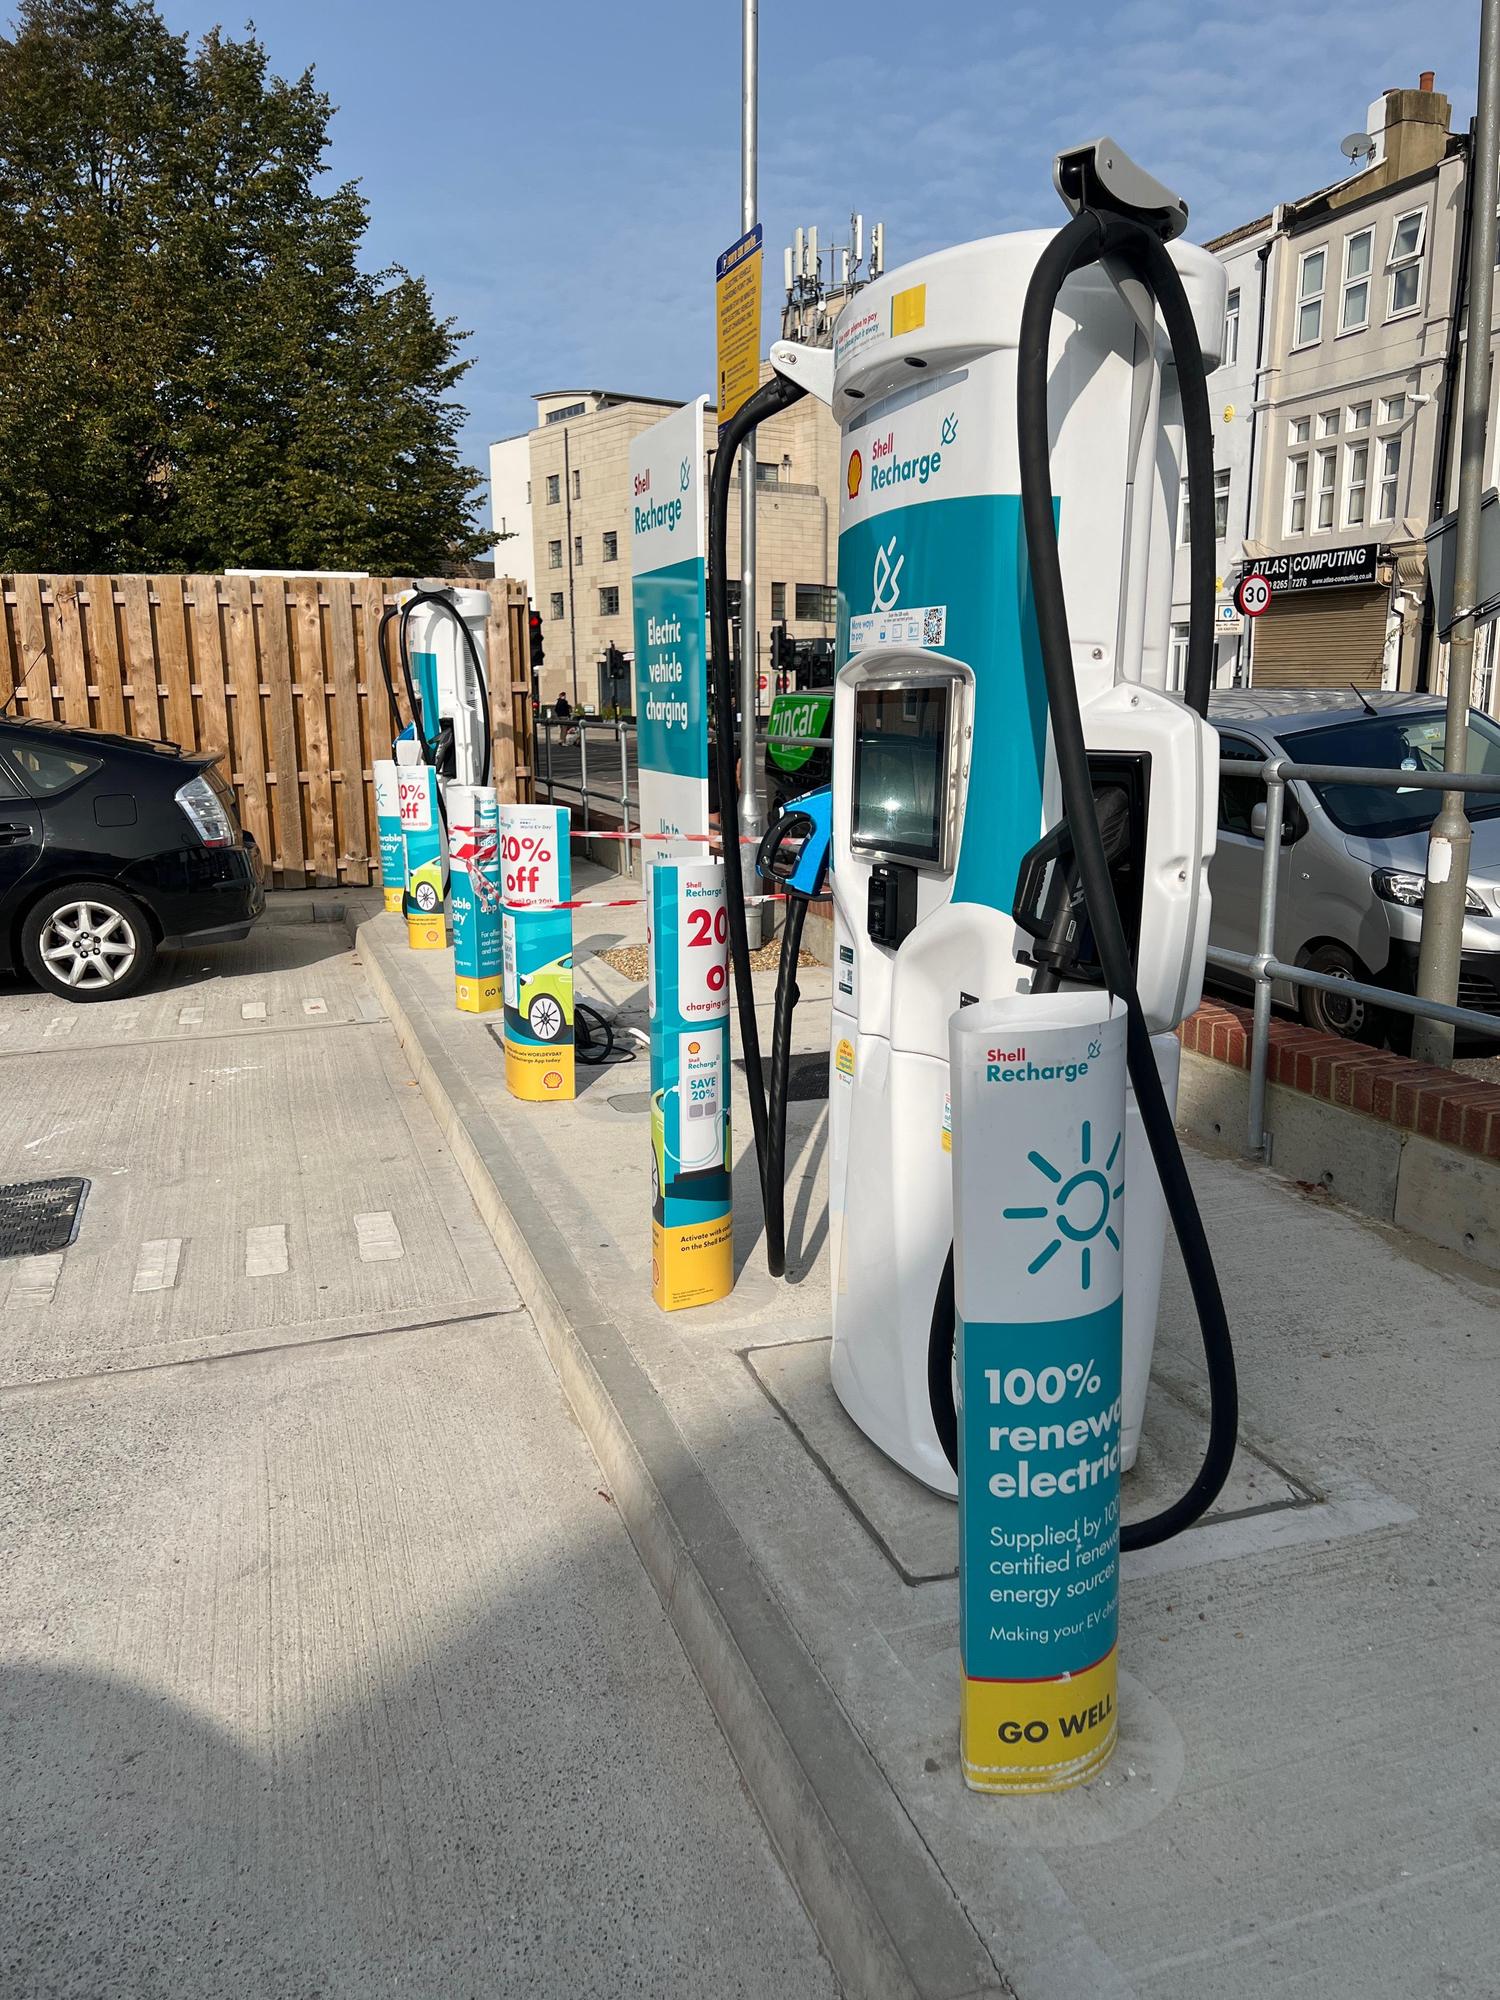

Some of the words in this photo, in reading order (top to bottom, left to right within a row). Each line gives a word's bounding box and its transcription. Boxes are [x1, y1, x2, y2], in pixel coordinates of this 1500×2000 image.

[872, 432, 894, 460] Shell
[634, 468, 650, 496] Shell
[871, 452, 941, 491] Recharge
[635, 497, 682, 535] Recharge
[1252, 559, 1288, 576] ATLAS
[1293, 549, 1366, 572] COMPUTING
[1245, 586, 1267, 602] 30
[1272, 580, 1288, 590] 8265
[1292, 578, 1307, 588] 7276
[1312, 572, 1372, 584] www.atlas-computing.co.uk
[648, 613, 681, 646] Electric
[856, 632, 864, 642] pay
[648, 652, 682, 683] vehicle
[646, 692, 688, 730] charging
[773, 701, 819, 738] zipcar
[399, 784, 426, 800] 0%
[501, 834, 551, 862] 20%
[506, 866, 540, 892] off
[686, 888, 722, 898] Recharge
[485, 987, 496, 997] GO
[686, 1000, 721, 1012] charging
[688, 1060, 716, 1070] Recharge
[987, 1048, 1026, 1062] Shell
[690, 1077, 716, 1090] SAVE
[987, 1062, 1088, 1082] Recharge
[692, 1089, 714, 1100] 20%
[680, 1233, 708, 1242] Activate
[709, 1228, 722, 1236] with
[704, 1239, 718, 1248] Shell
[985, 1359, 1101, 1406] 100%
[990, 1520, 1078, 1552] Supplied
[1084, 1516, 1101, 1538] by
[990, 1550, 1070, 1575] certified
[990, 1587, 1060, 1608] energy
[1066, 1561, 1116, 1598] sources
[990, 1626, 1049, 1644] Making
[1054, 1620, 1084, 1642] your
[1088, 1609, 1102, 1628] EV
[998, 1720, 1049, 1744] GO
[1058, 1694, 1112, 1738] WELL
